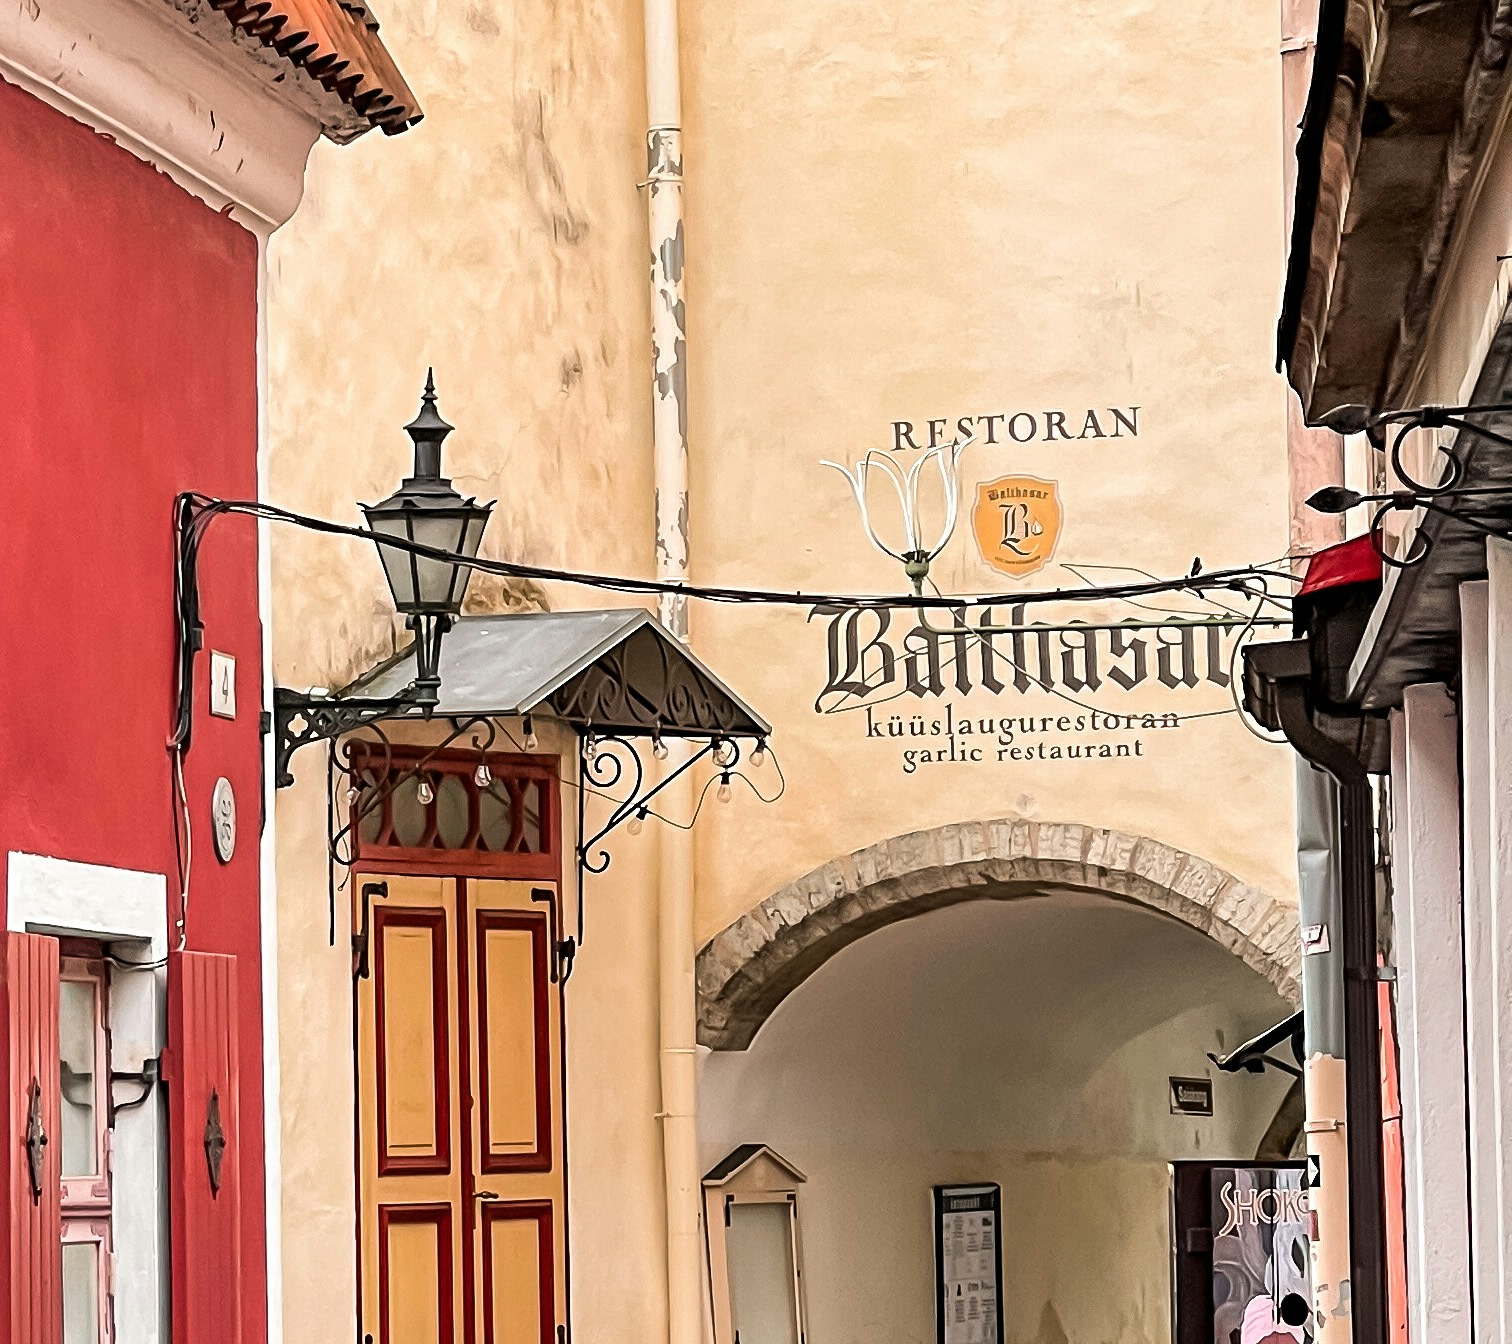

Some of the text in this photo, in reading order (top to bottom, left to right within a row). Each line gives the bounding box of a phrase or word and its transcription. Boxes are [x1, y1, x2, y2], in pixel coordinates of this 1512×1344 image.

[890, 406, 1141, 452] RESTORAN
[807, 603, 1233, 714] Balthasar
[865, 703, 1181, 745] küüslaugurestoran
[903, 735, 1144, 773] garlic restaurant
